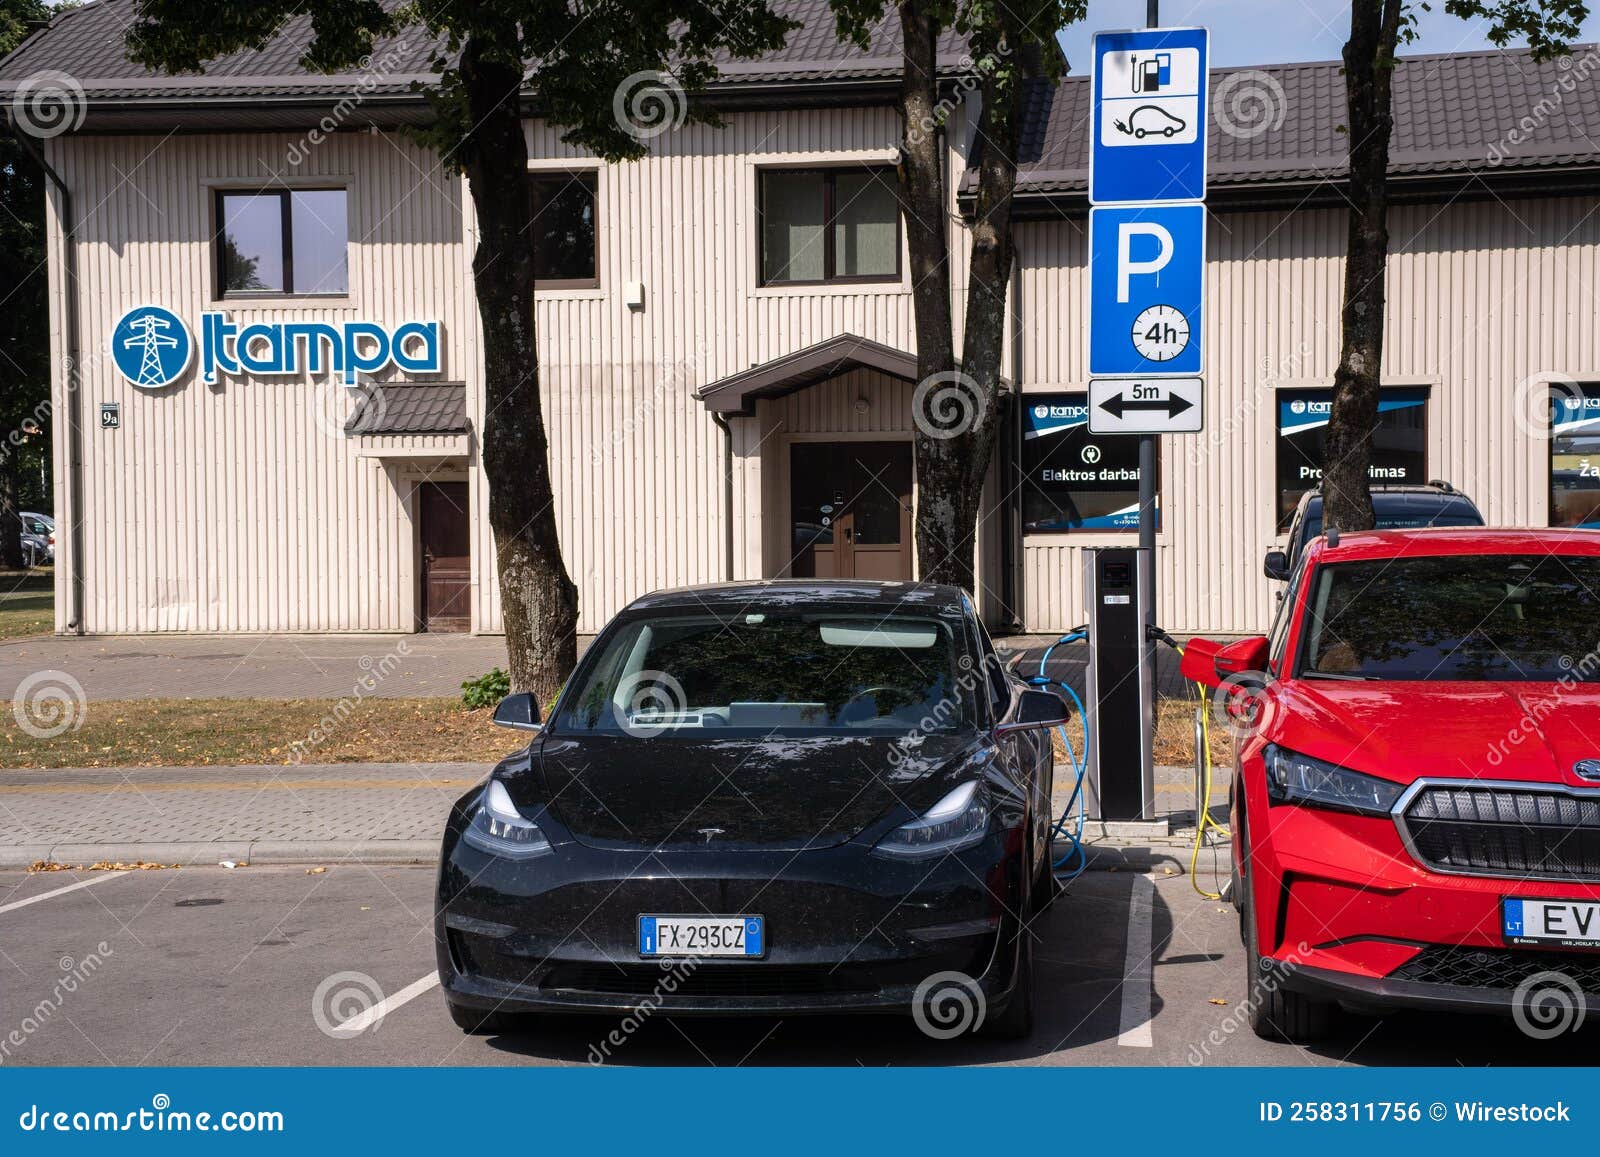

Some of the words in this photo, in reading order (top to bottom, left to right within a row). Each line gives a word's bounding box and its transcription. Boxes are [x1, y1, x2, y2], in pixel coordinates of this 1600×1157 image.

[1117, 222, 1174, 303] P
[1144, 322, 1177, 344] 4h
[1132, 384, 1160, 399] 5m
[103, 411, 117, 425] 9a
[1042, 468, 1096, 481] Elektros
[1099, 467, 1140, 481] darbai
[1507, 921, 1521, 931] LT
[1543, 904, 1600, 936] EV
